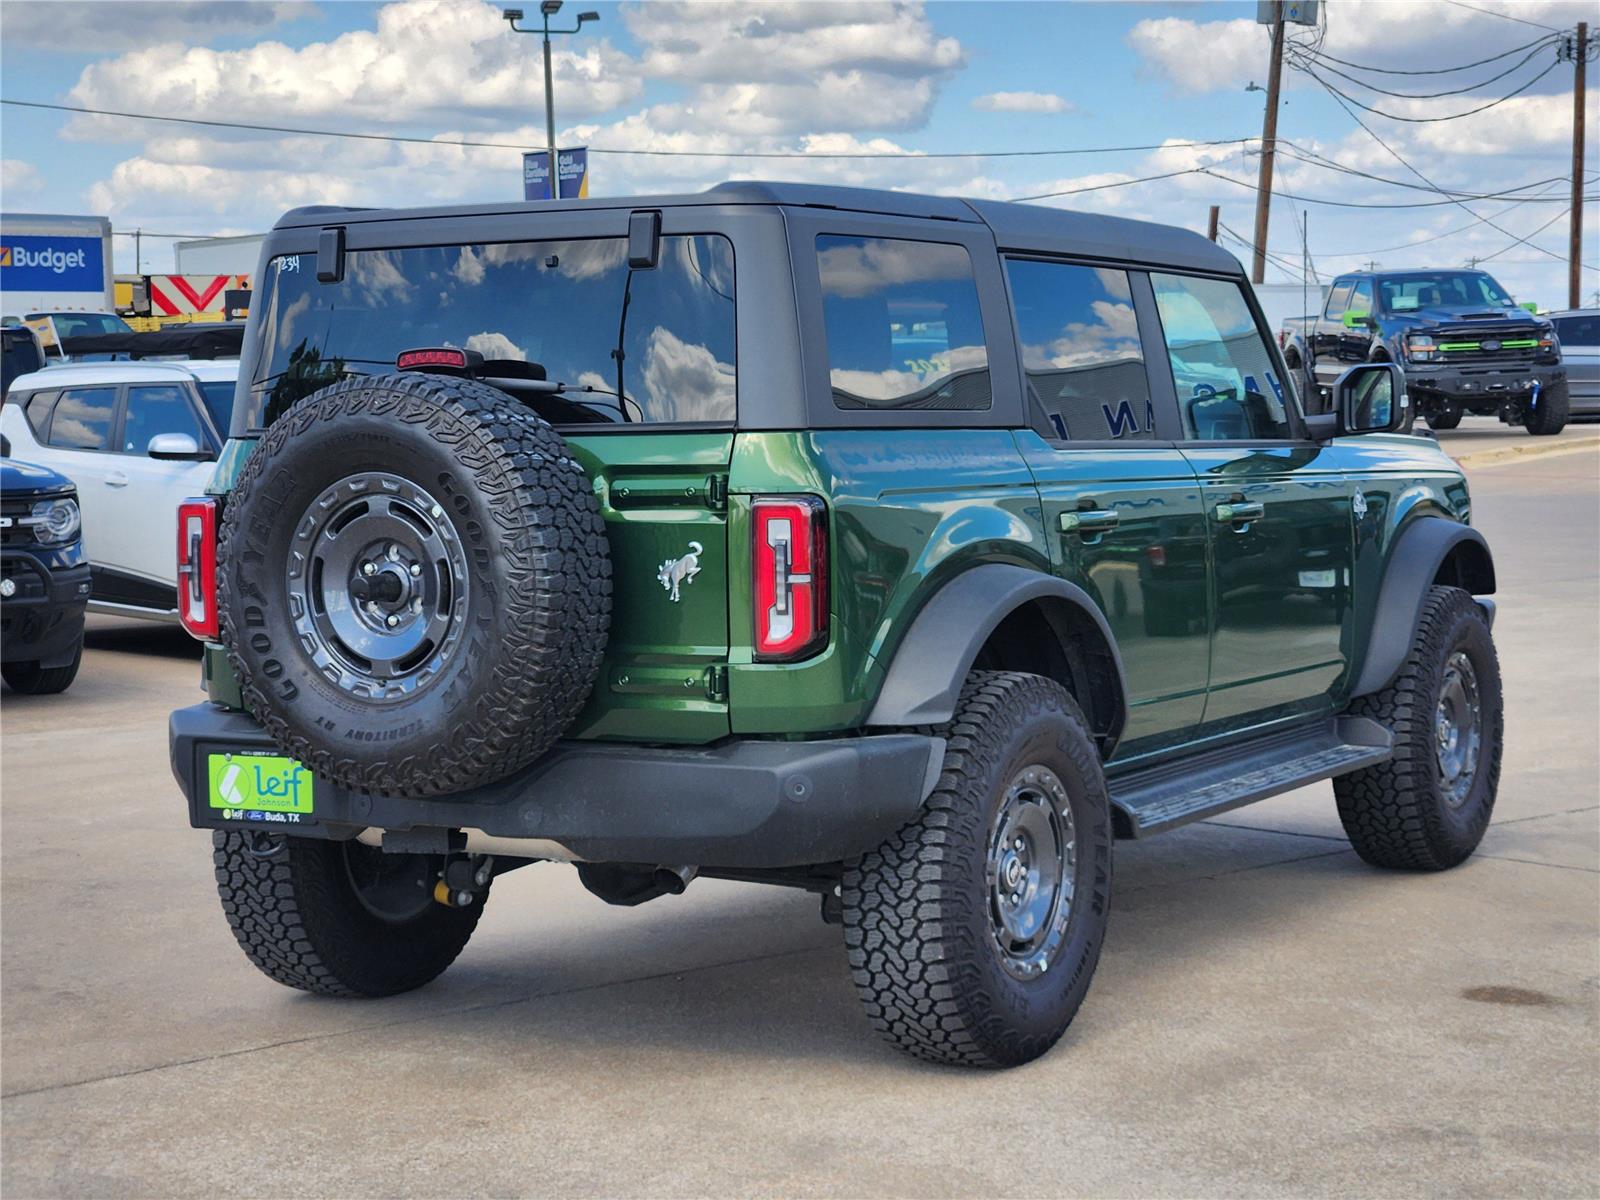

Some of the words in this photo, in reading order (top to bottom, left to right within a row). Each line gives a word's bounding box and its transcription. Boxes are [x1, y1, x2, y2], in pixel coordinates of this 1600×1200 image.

[13, 247, 86, 273] Budget
[344, 719, 424, 742] TERRITORY
[253, 765, 304, 807] leif
[265, 811, 287, 823] Buda,
[287, 813, 300, 823] TX
